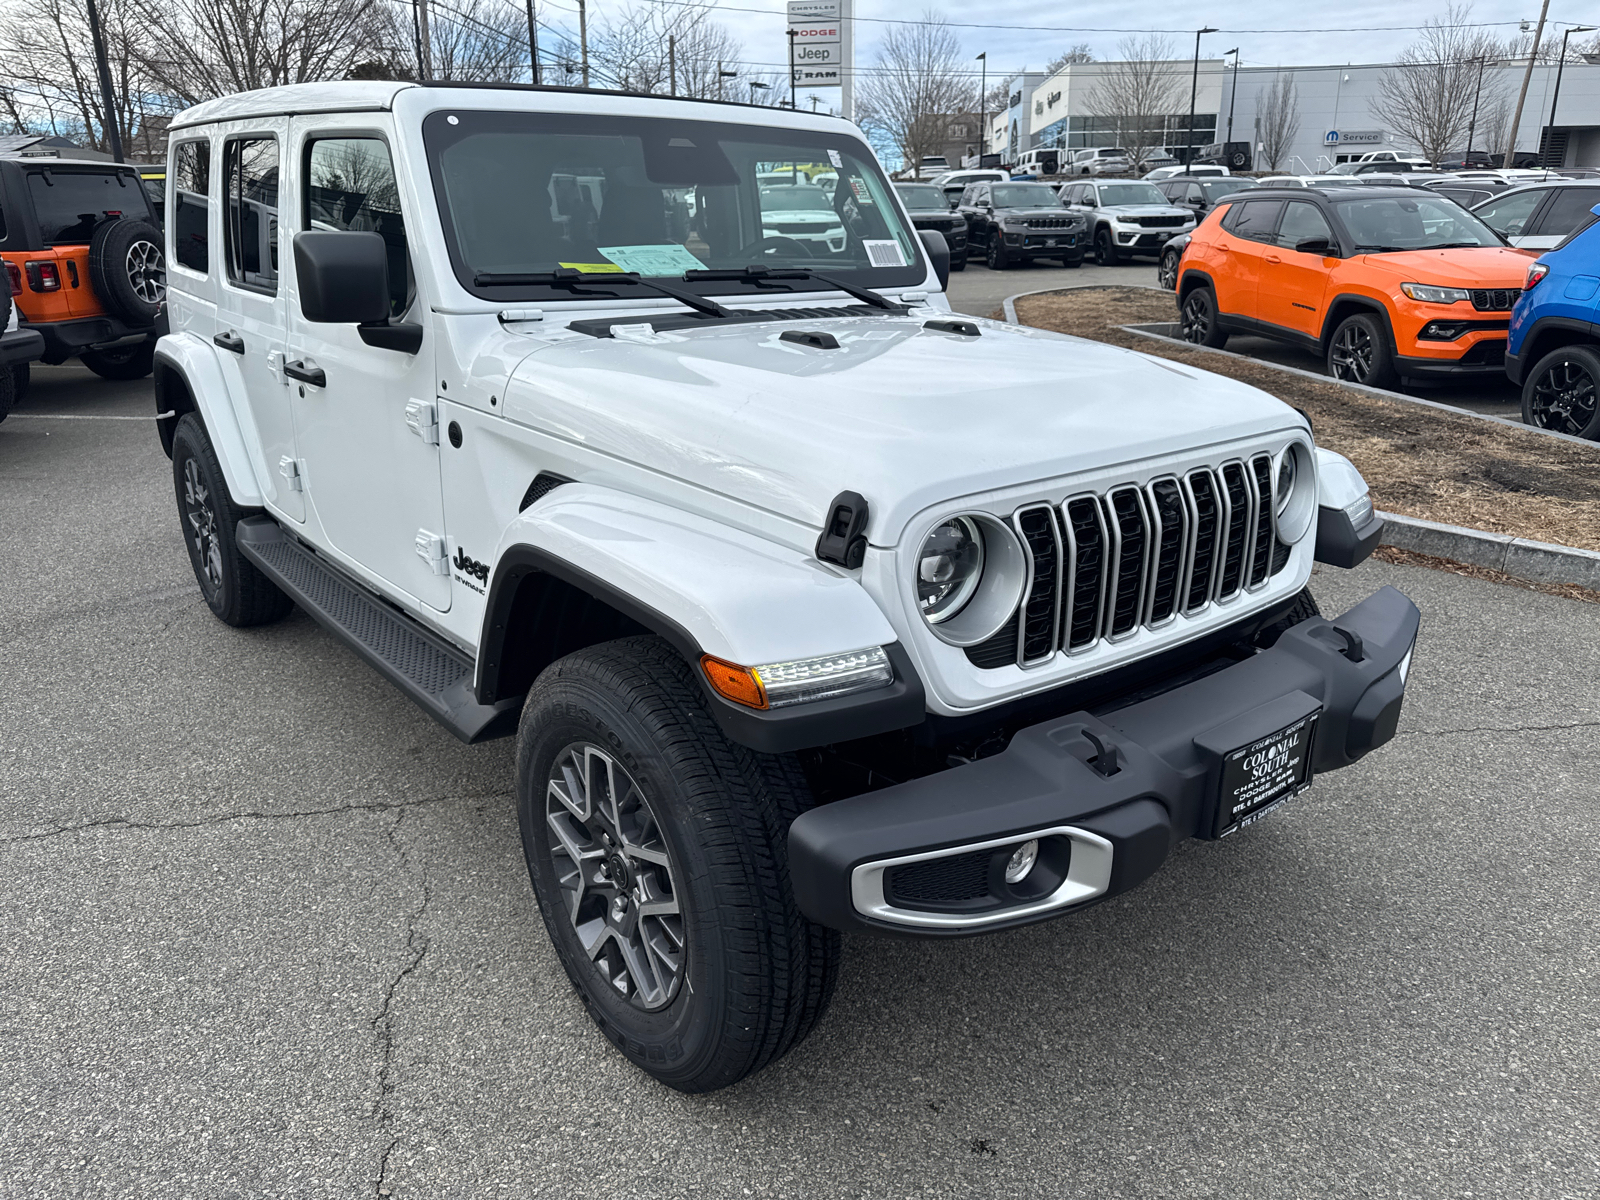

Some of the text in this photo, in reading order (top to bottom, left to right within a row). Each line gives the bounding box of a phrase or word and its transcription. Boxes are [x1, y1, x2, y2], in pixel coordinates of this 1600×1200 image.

[798, 47, 830, 61] Jeep
[1233, 756, 1300, 795] CHRYSLER Jeep
[1251, 750, 1289, 780] SOUTH
[1287, 776, 1295, 784] MA
[1239, 769, 1293, 801] DODGE RAM
